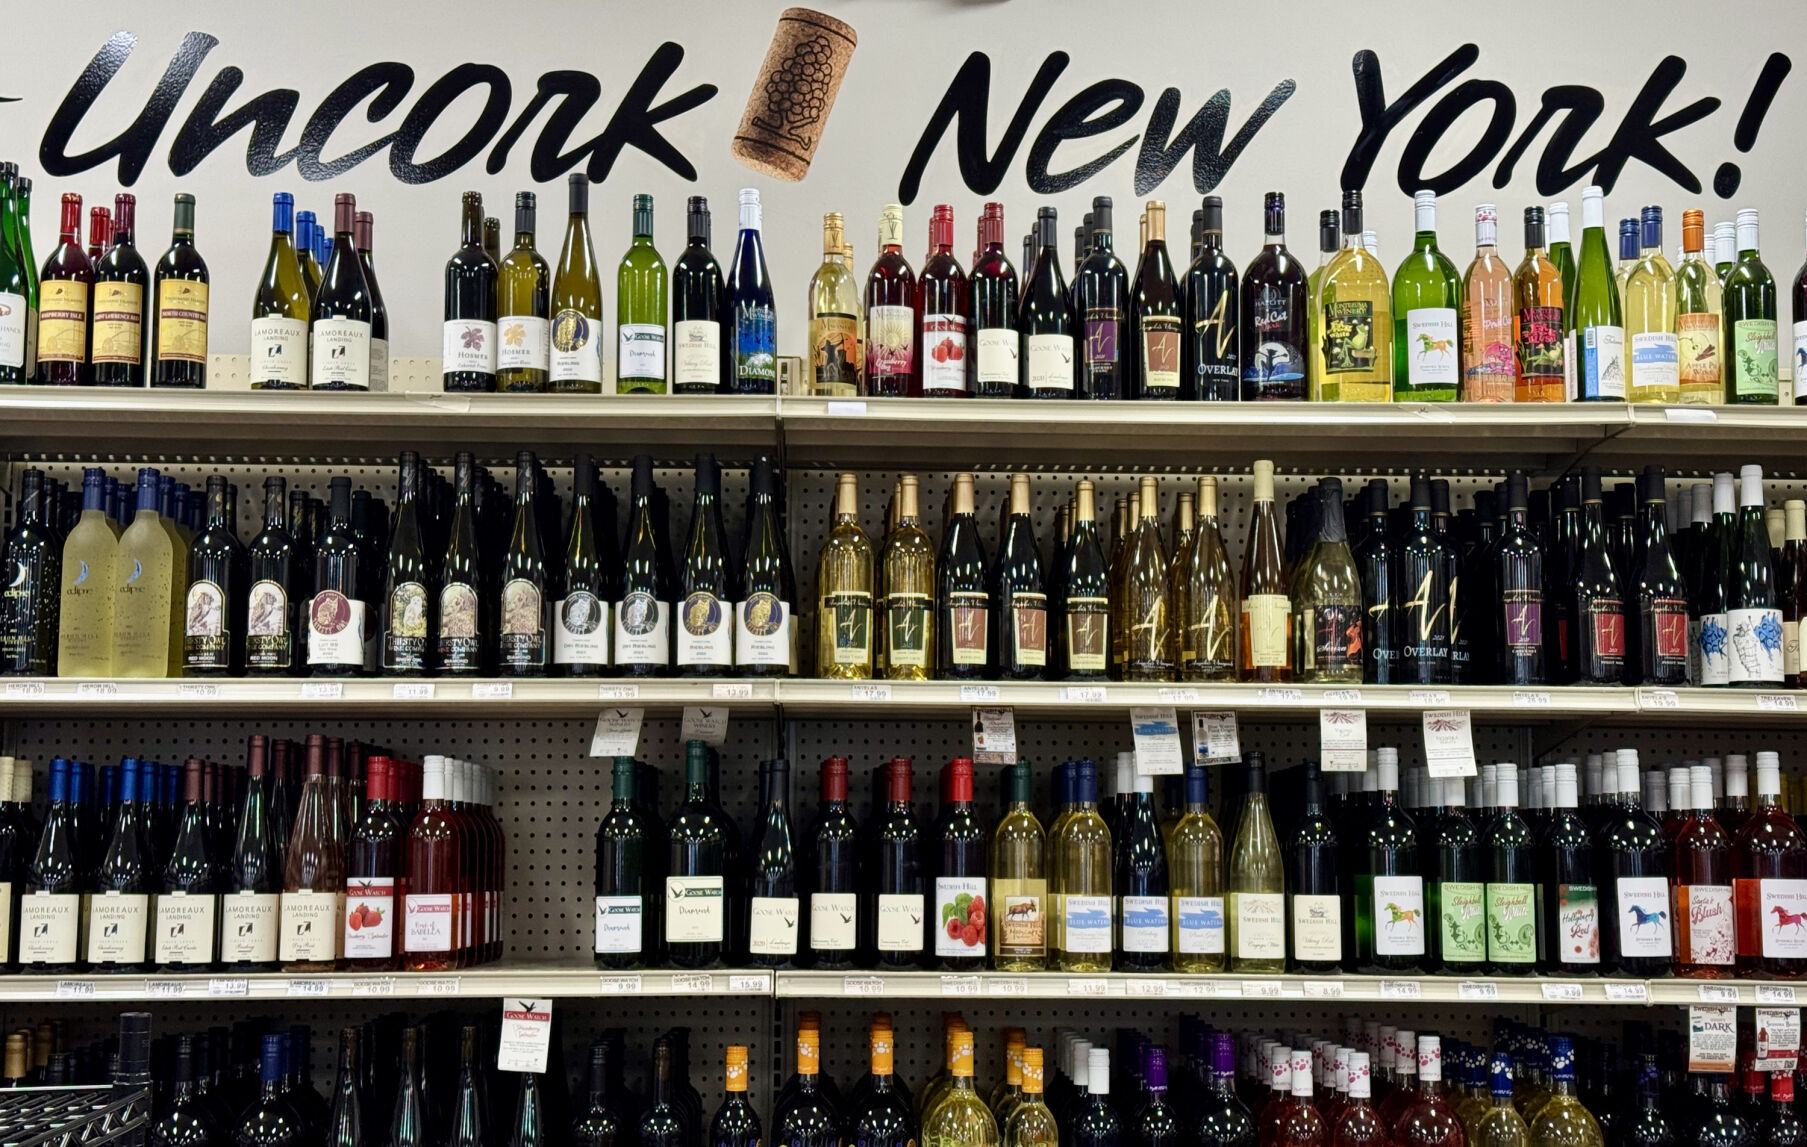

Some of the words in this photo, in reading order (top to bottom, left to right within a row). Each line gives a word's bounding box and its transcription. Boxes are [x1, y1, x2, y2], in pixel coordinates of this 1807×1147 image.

[39, 30, 718, 184] Uncork
[898, 50, 1297, 205] New
[1340, 43, 1791, 199] York!
[1255, 315, 1269, 327] Red
[1270, 311, 1288, 322] Cat
[255, 328, 300, 337] LAMOREAUX
[318, 329, 363, 338] LAMOREAUX
[458, 352, 488, 360] HOSMER
[1198, 364, 1238, 377] OVERLAY
[1686, 362, 1708, 371] APPLE
[740, 365, 775, 378] DIAMON
[1403, 645, 1448, 658] OVERLAY
[1766, 892, 1795, 900] SWEDISH
[1451, 895, 1482, 907] Sleighbell
[1494, 895, 1528, 907] Sleighbell
[158, 906, 205, 914] LAMOREAUX
[225, 905, 272, 913] LAMOREAUX
[753, 908, 773, 916] GOOSE
[812, 904, 830, 912] GOOSE
[880, 904, 900, 913] GOOSE
[1691, 902, 1722, 925] Blush
[1562, 911, 1594, 926] Hollyberry
[1570, 924, 1590, 938] Red
[956, 985, 978, 993] 10.99
[1002, 985, 1025, 993] 10.99
[1083, 984, 1106, 992] 11.99
[1141, 985, 1164, 993] 12.99
[1261, 987, 1279, 995] 9.99
[1323, 987, 1341, 995] 8.99
[1564, 989, 1581, 997] 9.99
[1772, 990, 1793, 998] 14.99
[526, 1012, 547, 1020] WATCH
[1704, 1022, 1735, 1033] DARK
